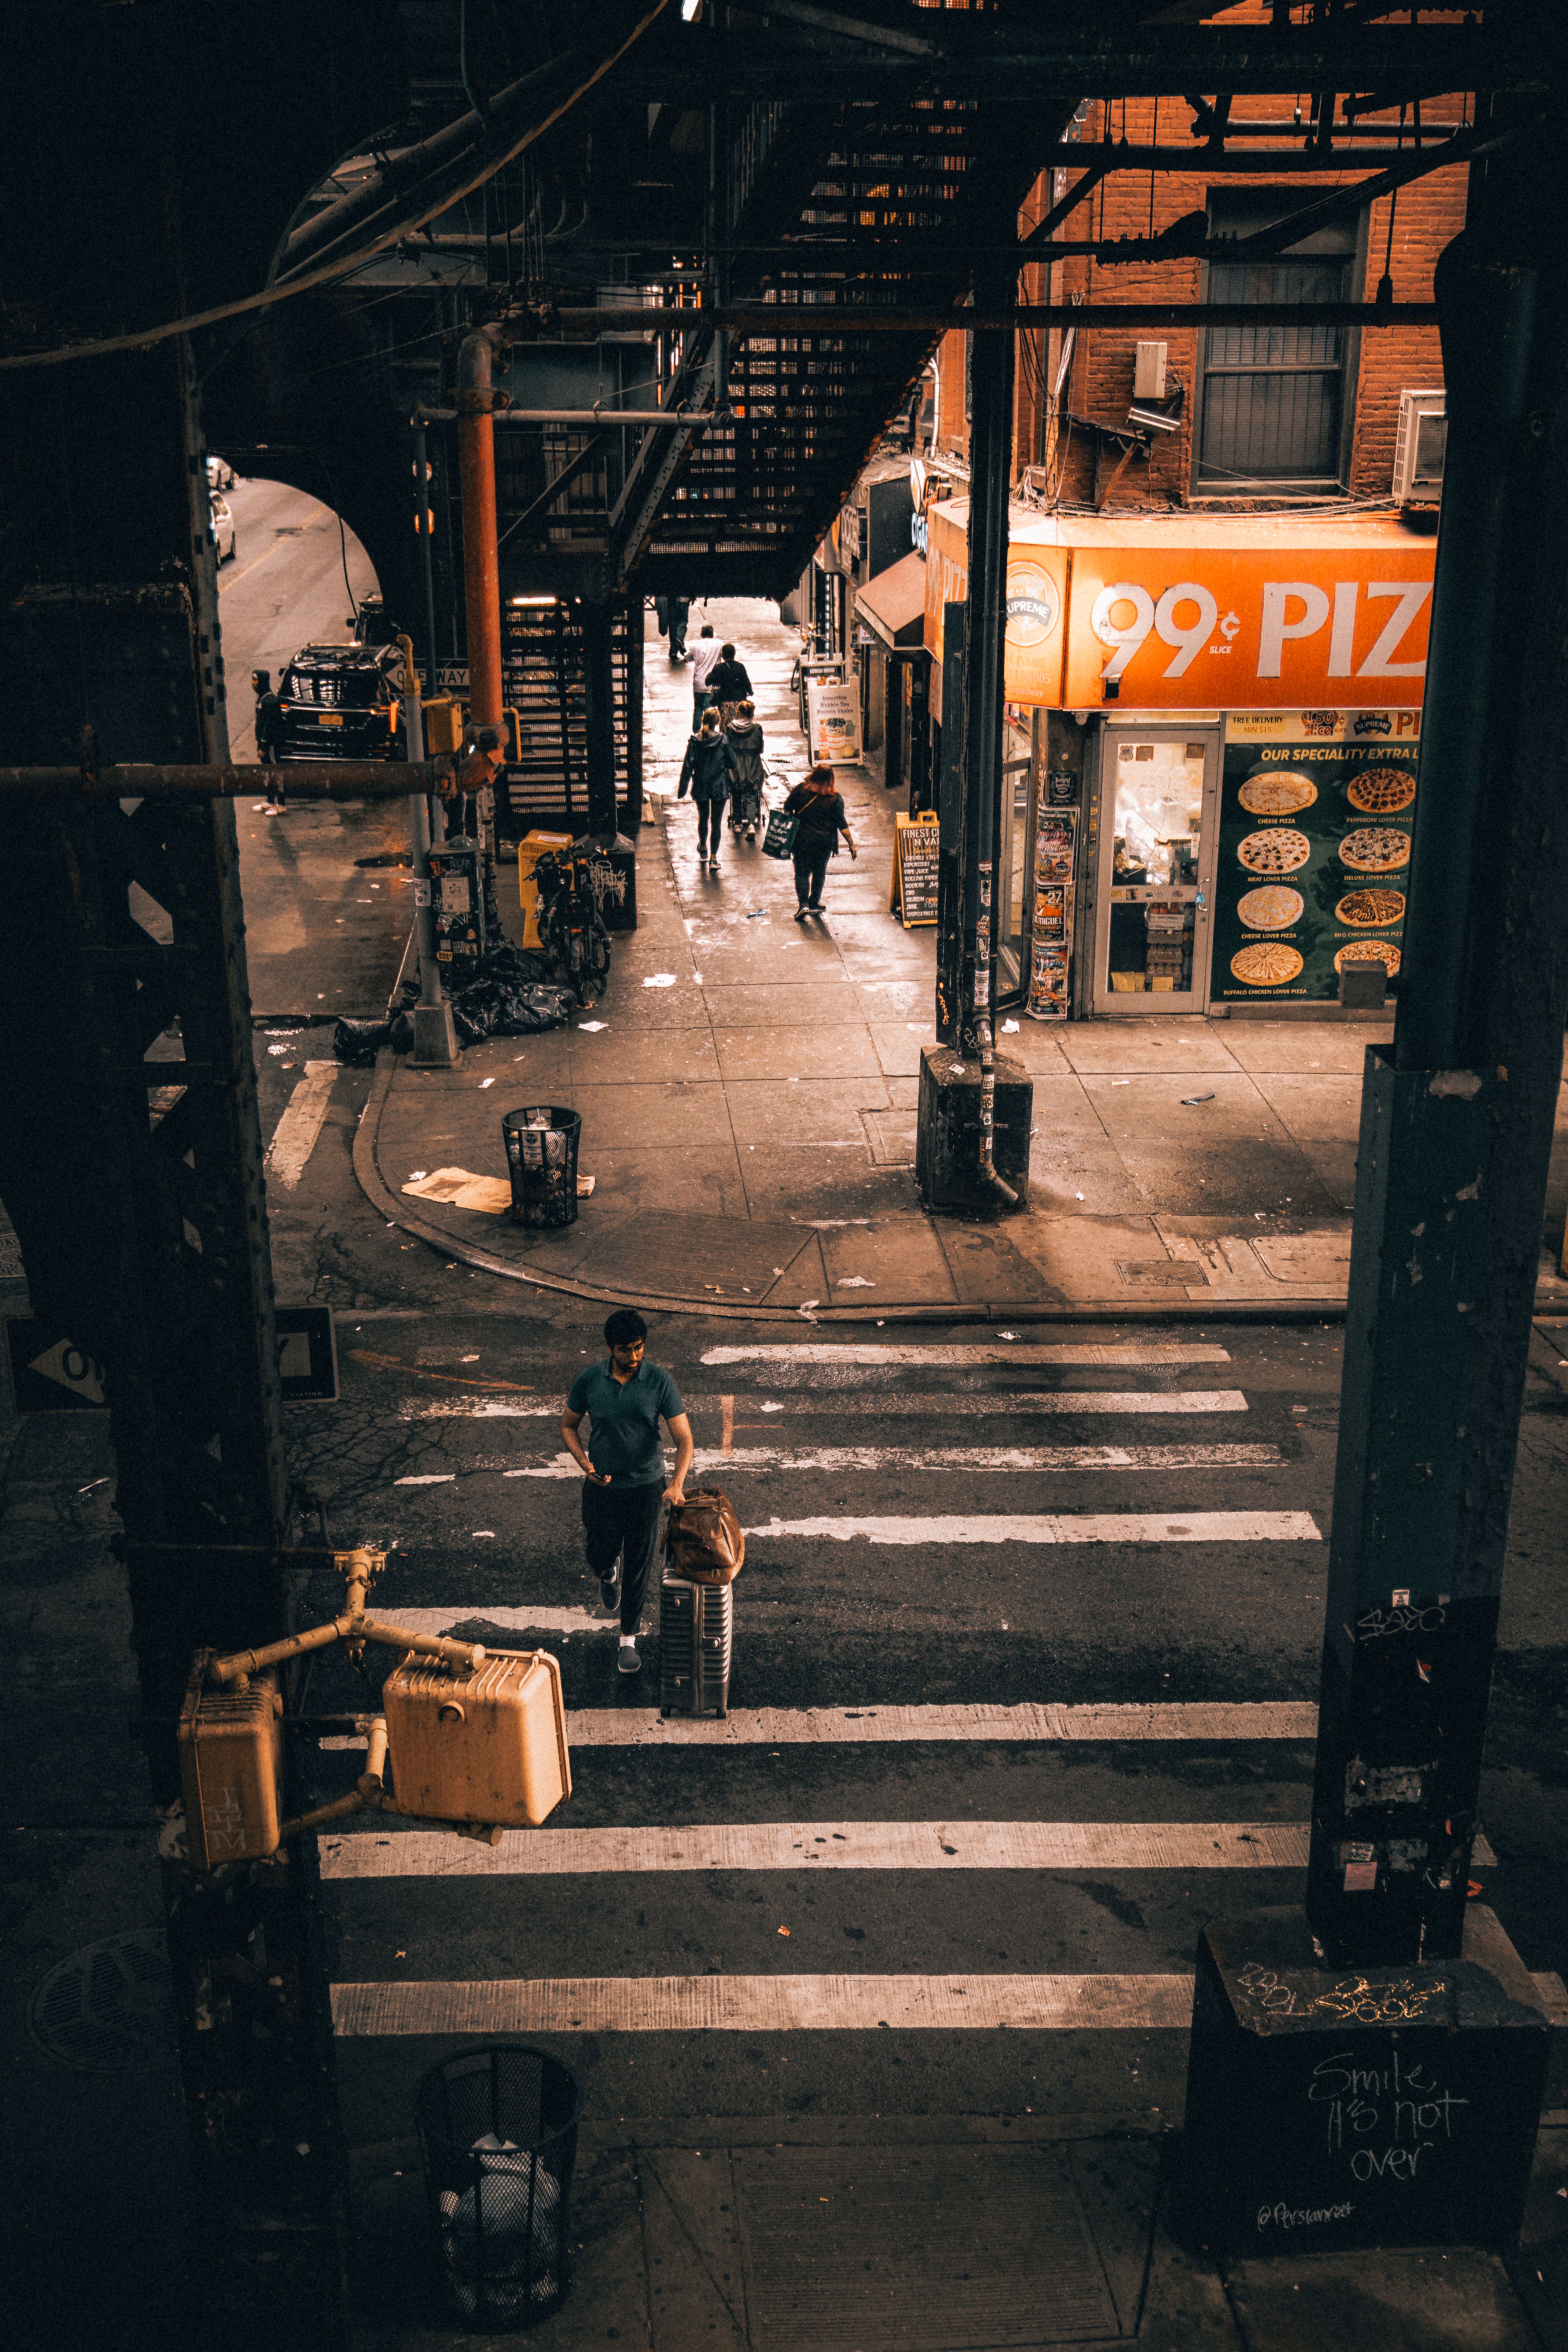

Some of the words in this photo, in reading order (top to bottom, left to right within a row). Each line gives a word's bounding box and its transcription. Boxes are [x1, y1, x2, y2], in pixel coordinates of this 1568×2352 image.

[1007, 600, 1050, 619] UPREME
[1209, 645, 1232, 654] SLICE
[397, 670, 427, 684] OE
[436, 671, 466, 684] WAY
[1356, 720, 1391, 731] SUPREME
[1261, 749, 1290, 761] OUR
[1292, 748, 1367, 761] SPECIALITY
[1367, 748, 1410, 760] EXTRA
[903, 828, 930, 839] FINEST
[1048, 892, 1062, 903] 27
[1038, 917, 1063, 925] MIGUEL
[1308, 2050, 1436, 2100] Smile,
[1395, 2090, 1469, 2141] not
[1351, 2142, 1434, 2180] over
